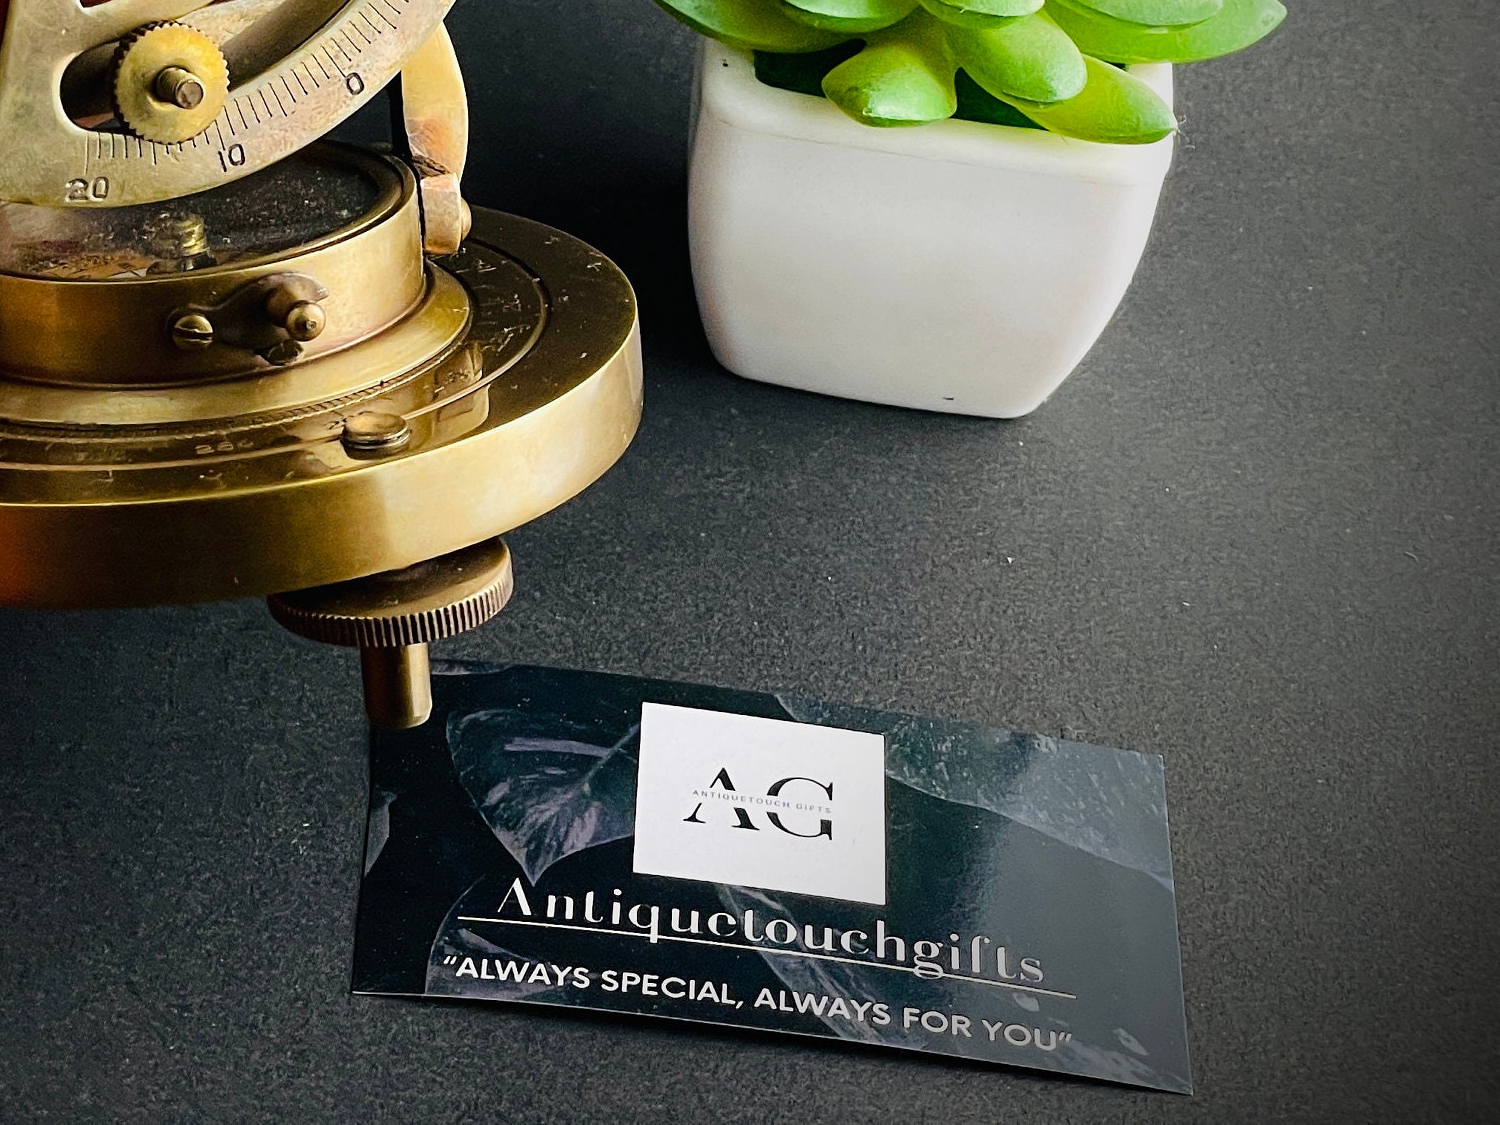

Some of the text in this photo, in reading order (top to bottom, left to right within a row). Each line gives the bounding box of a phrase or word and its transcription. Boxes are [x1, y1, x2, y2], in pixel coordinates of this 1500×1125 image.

[346, 73, 365, 96] 0
[217, 143, 246, 173] 10
[64, 175, 110, 202] 20
[682, 766, 834, 841] AG
[692, 789, 832, 815] ANTIQUETOUCH GIFTS
[497, 877, 1045, 984] Antiquetouchgifts
[600, 969, 744, 1010] SPECIAL,
[753, 987, 892, 1025] ALWAYS
[902, 1006, 973, 1039] FOR
